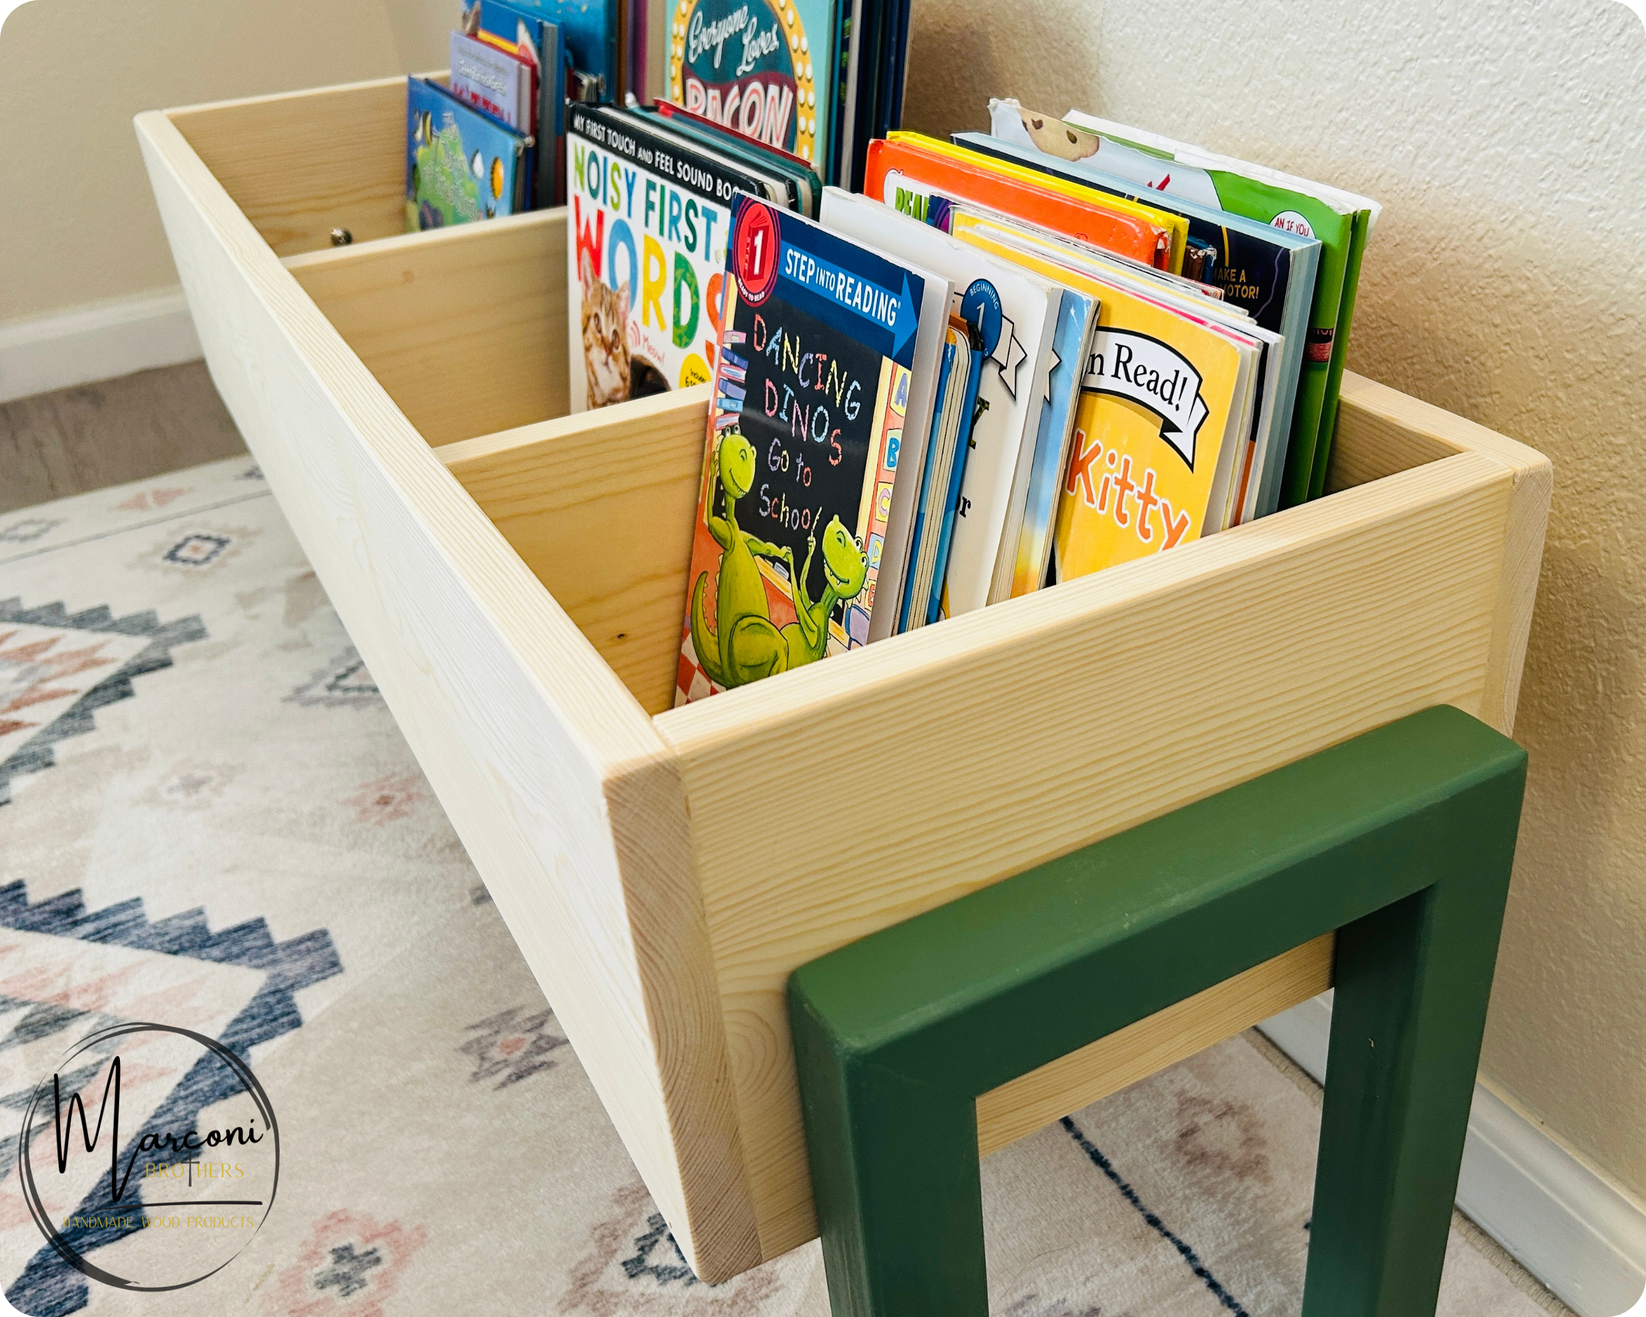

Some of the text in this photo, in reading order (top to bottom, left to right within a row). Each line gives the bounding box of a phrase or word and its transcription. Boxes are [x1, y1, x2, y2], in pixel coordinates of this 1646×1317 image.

[688, 5, 749, 69] Everyone
[736, 16, 780, 77] Loves
[573, 113, 585, 132] MY
[585, 118, 606, 140] FIRST
[607, 129, 636, 157] TOUCH
[637, 147, 653, 164] AND
[654, 152, 674, 175] FEEL
[677, 161, 713, 192] SOUND
[573, 141, 637, 219] NOISY
[645, 178, 718, 262] FIRST
[1286, 220, 1294, 232] IF
[1295, 223, 1310, 237] YOU
[754, 229, 764, 276] 1
[784, 248, 816, 285] STEP
[815, 267, 836, 291] INTO
[1239, 269, 1247, 283] A
[969, 282, 999, 310] BEGINNING
[976, 301, 985, 334] 1
[753, 313, 861, 421] DANCING
[1111, 343, 1188, 412] Read!
[765, 378, 842, 467] DINOS
[768, 437, 812, 488] Go to
[1065, 429, 1191, 550] Kitty
[758, 483, 823, 534] School
